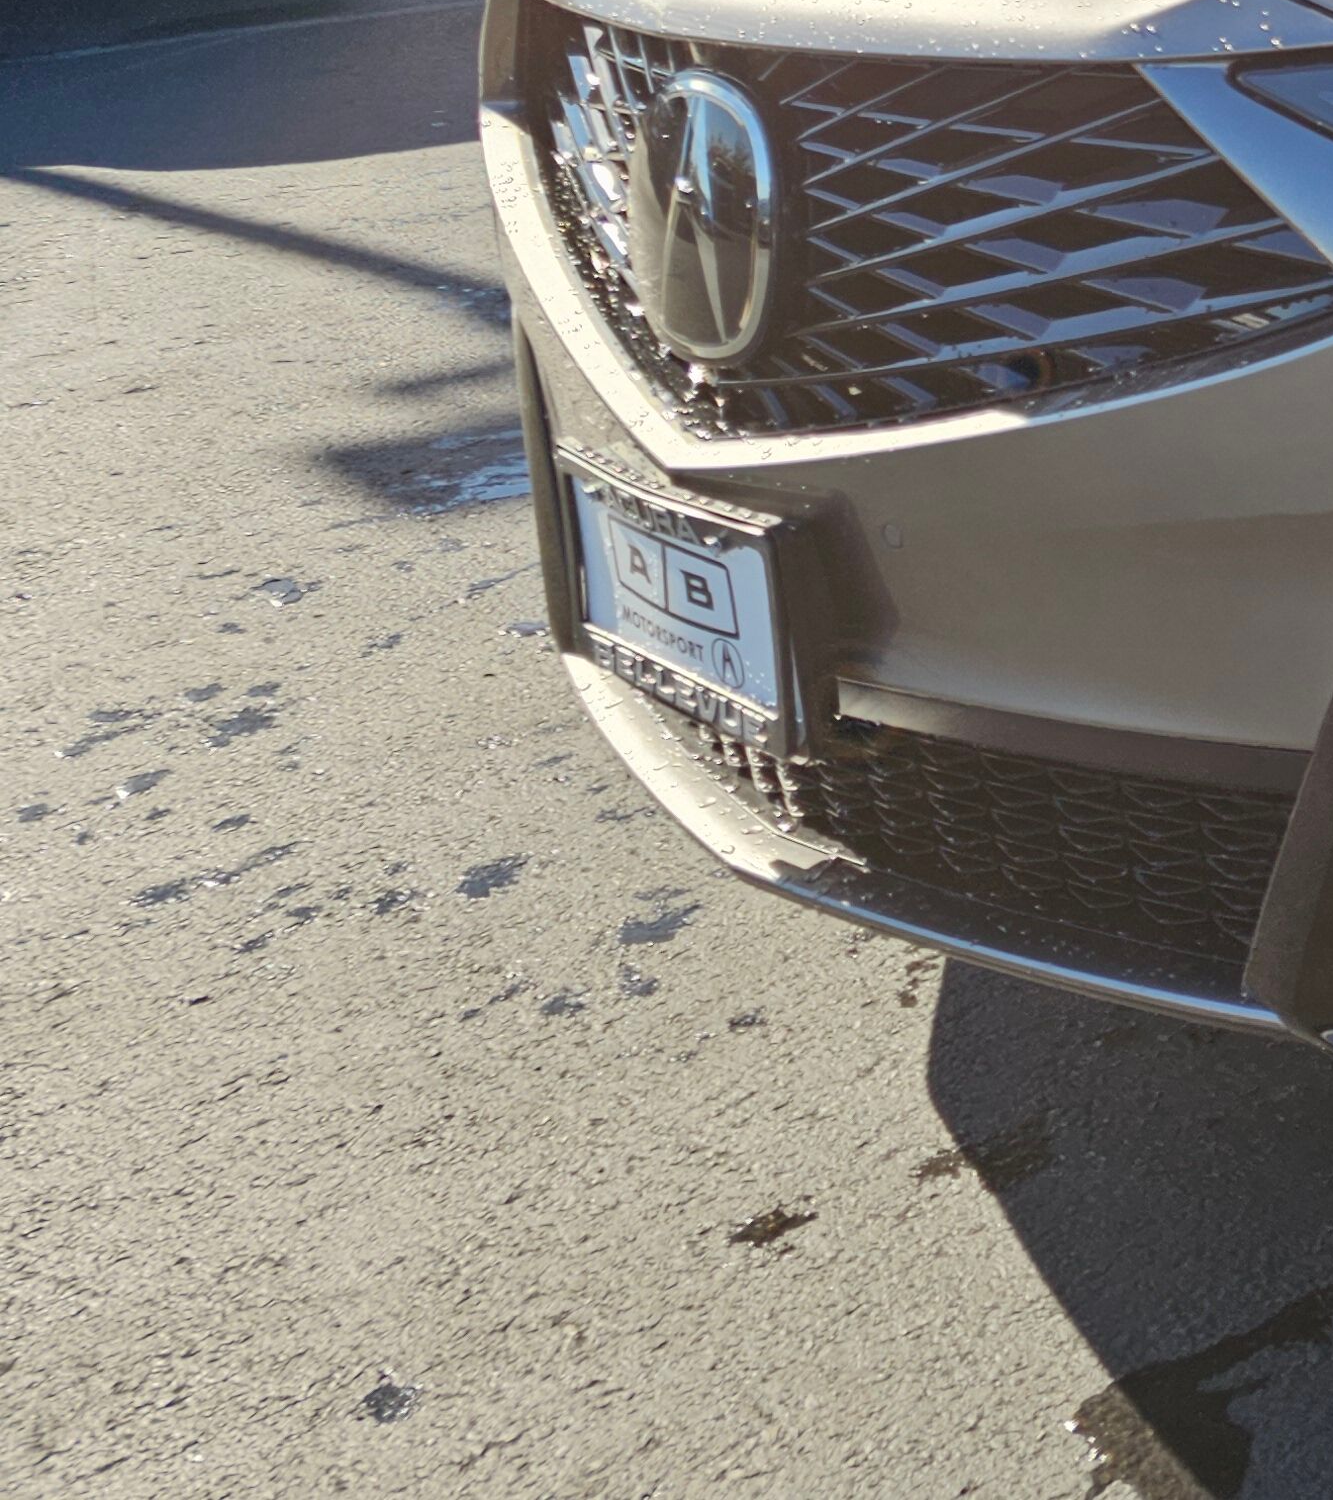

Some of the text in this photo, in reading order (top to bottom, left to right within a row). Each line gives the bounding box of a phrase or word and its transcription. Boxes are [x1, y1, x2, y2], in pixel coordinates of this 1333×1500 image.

[628, 543, 715, 611] A B
[622, 604, 704, 662] MOTORSPORT
[593, 634, 768, 750] BELLEVUE
